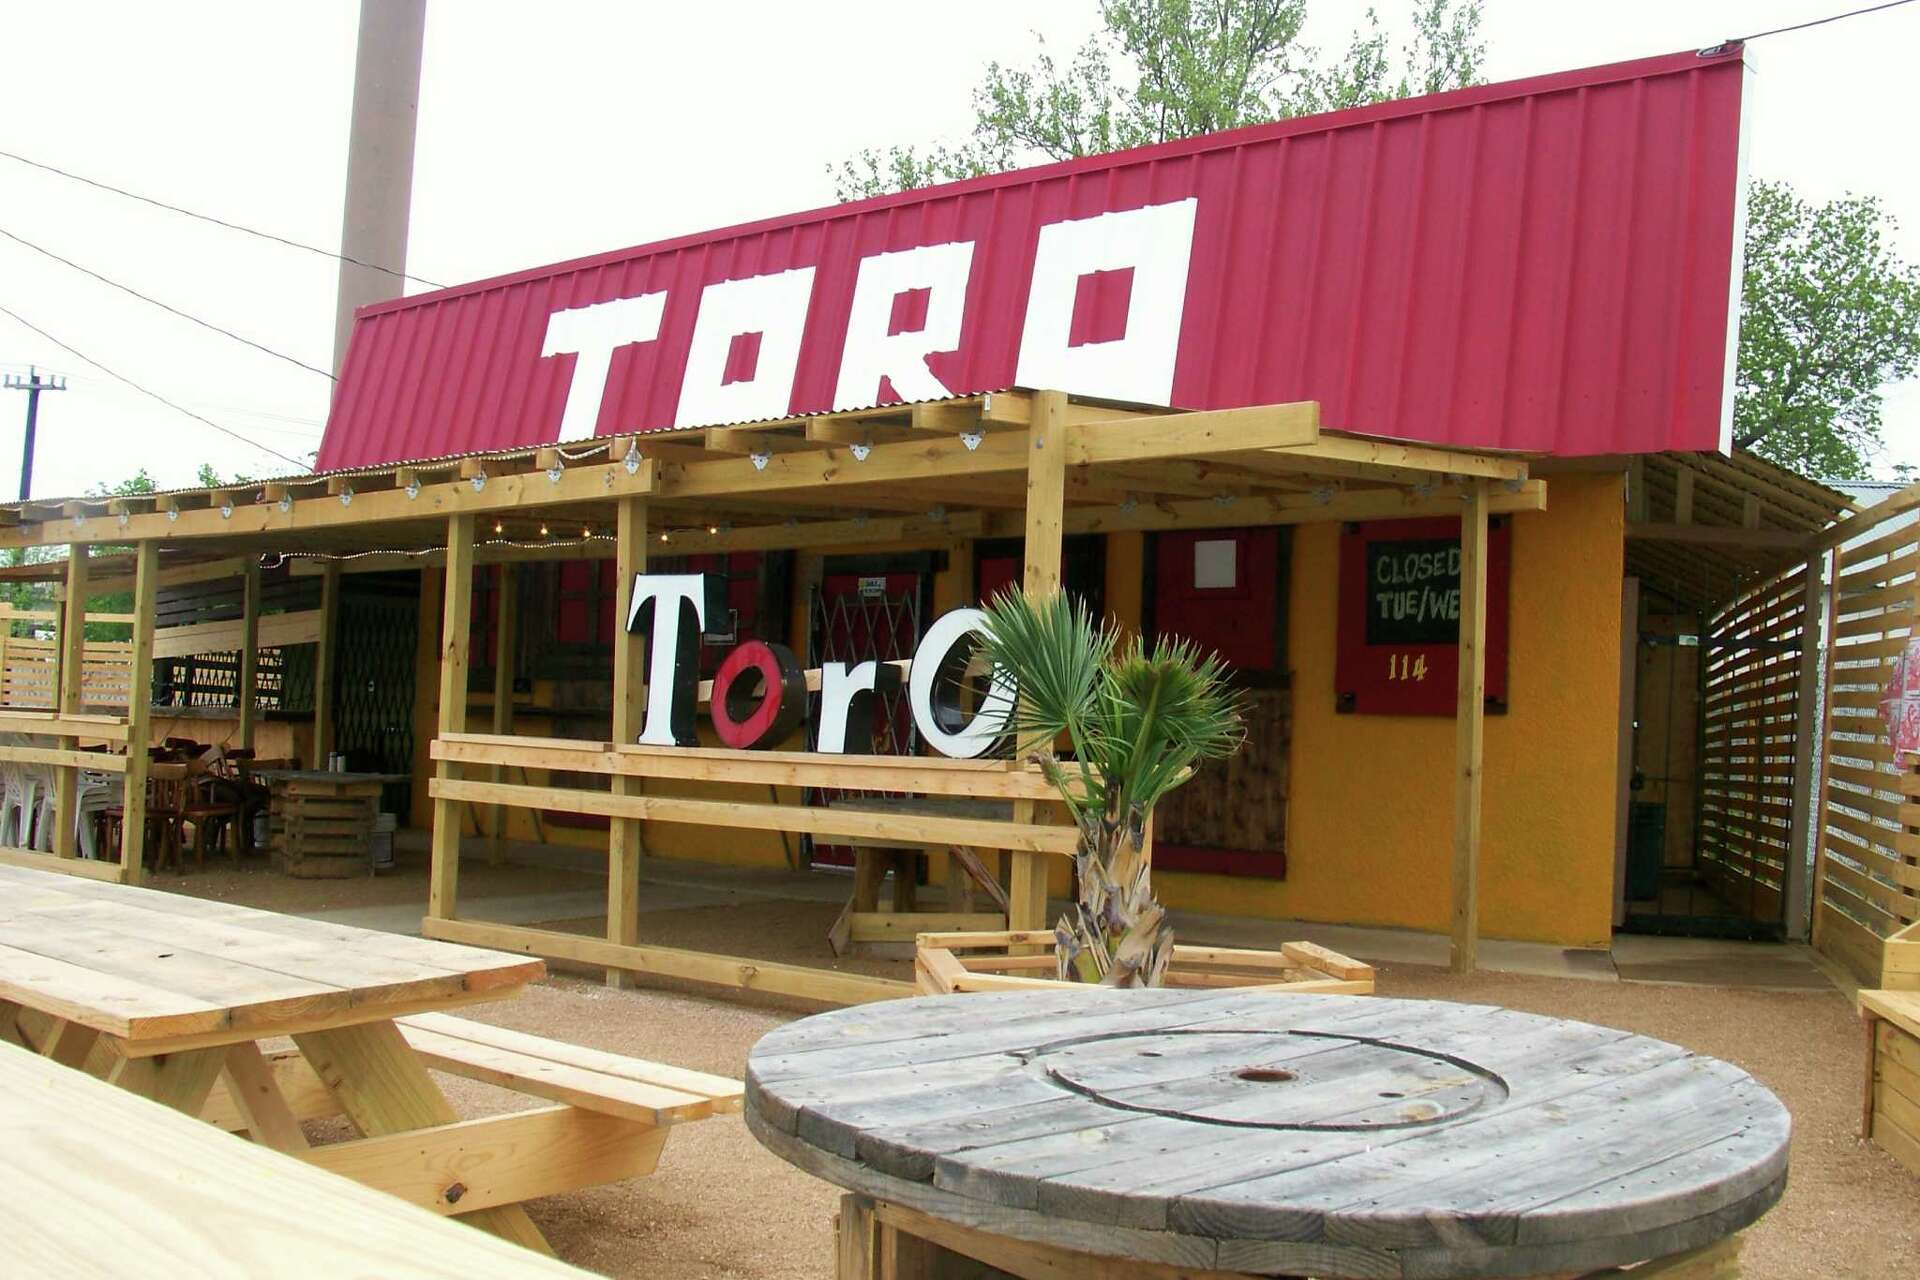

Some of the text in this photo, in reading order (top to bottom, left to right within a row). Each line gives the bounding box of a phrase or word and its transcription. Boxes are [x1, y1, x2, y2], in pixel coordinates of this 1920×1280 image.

[540, 197, 1198, 442] TORO
[1376, 548, 1460, 584] CLOSED
[1376, 586, 1460, 623] TUE/WE
[1388, 653, 1428, 681] 114
